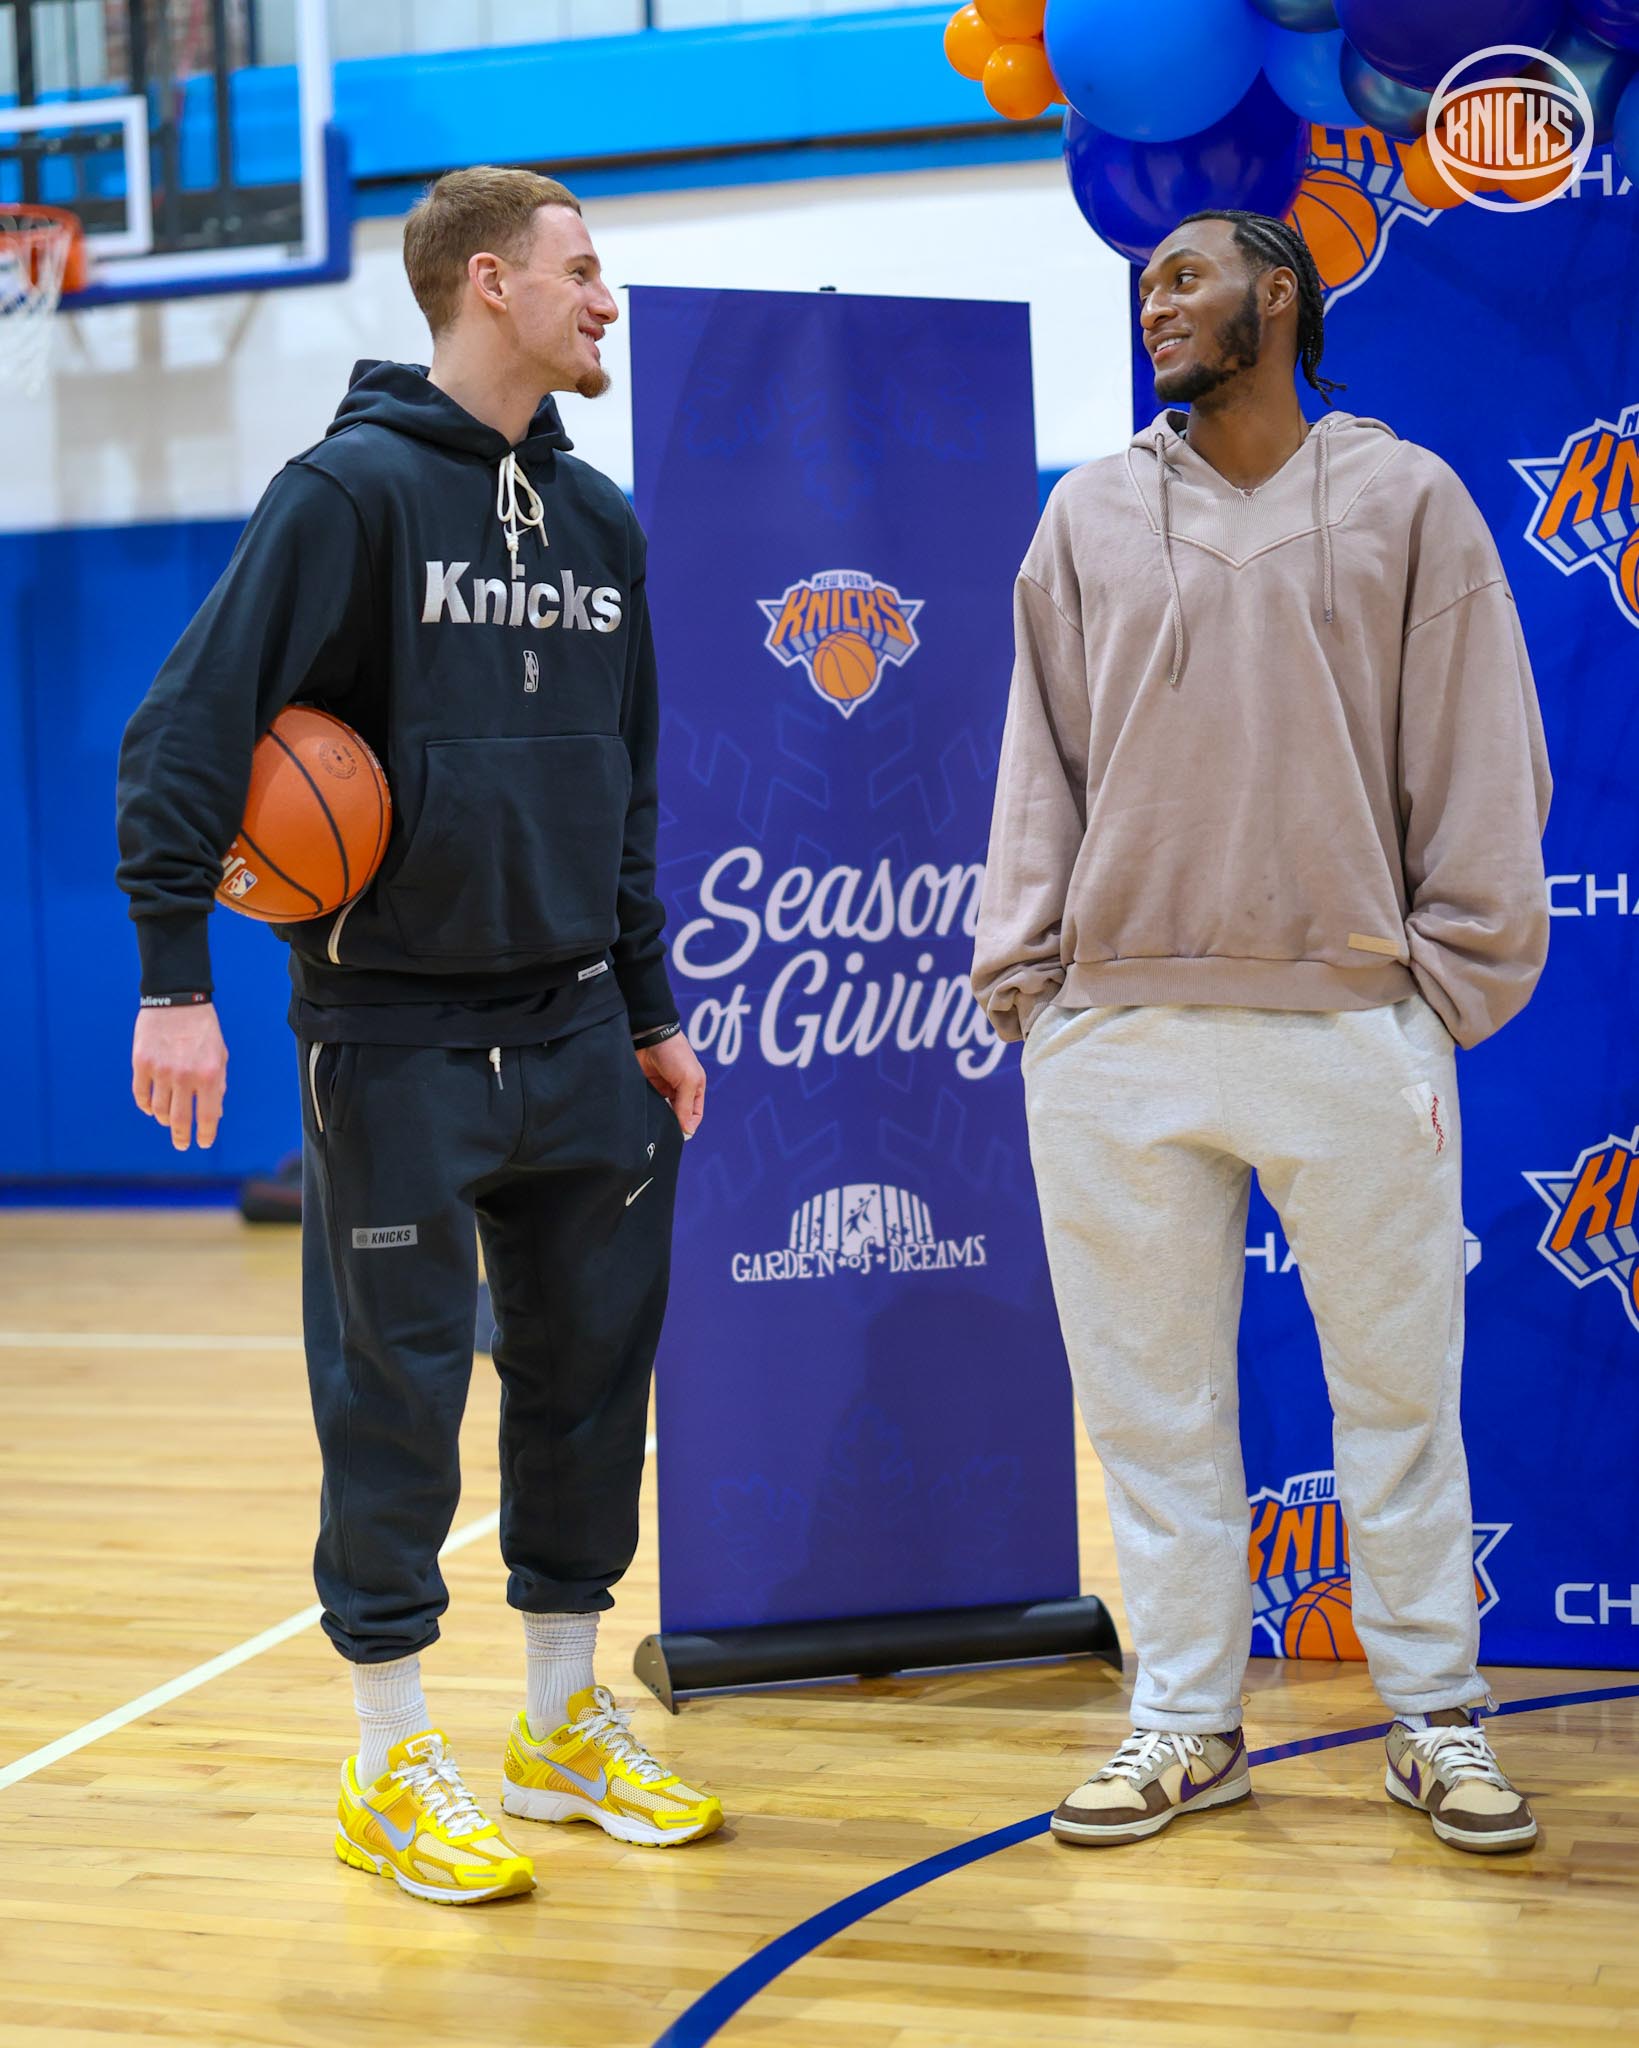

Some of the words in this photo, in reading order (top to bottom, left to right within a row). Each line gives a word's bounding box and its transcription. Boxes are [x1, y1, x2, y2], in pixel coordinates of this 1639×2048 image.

[421, 561, 622, 633] Knicks
[815, 575, 839, 588] NEW
[841, 574, 871, 588] YORK
[771, 588, 913, 646] KNICKS
[672, 846, 988, 979] Season
[1545, 873, 1639, 917] CH
[688, 984, 751, 1065] of
[371, 1230, 411, 1244] KNICKS
[731, 1249, 836, 1283] GARDEN
[847, 1236, 872, 1274] of
[889, 1235, 987, 1273] DREAMS
[1286, 1476, 1334, 1504] NEW
[1248, 1501, 1350, 1584] KNI
